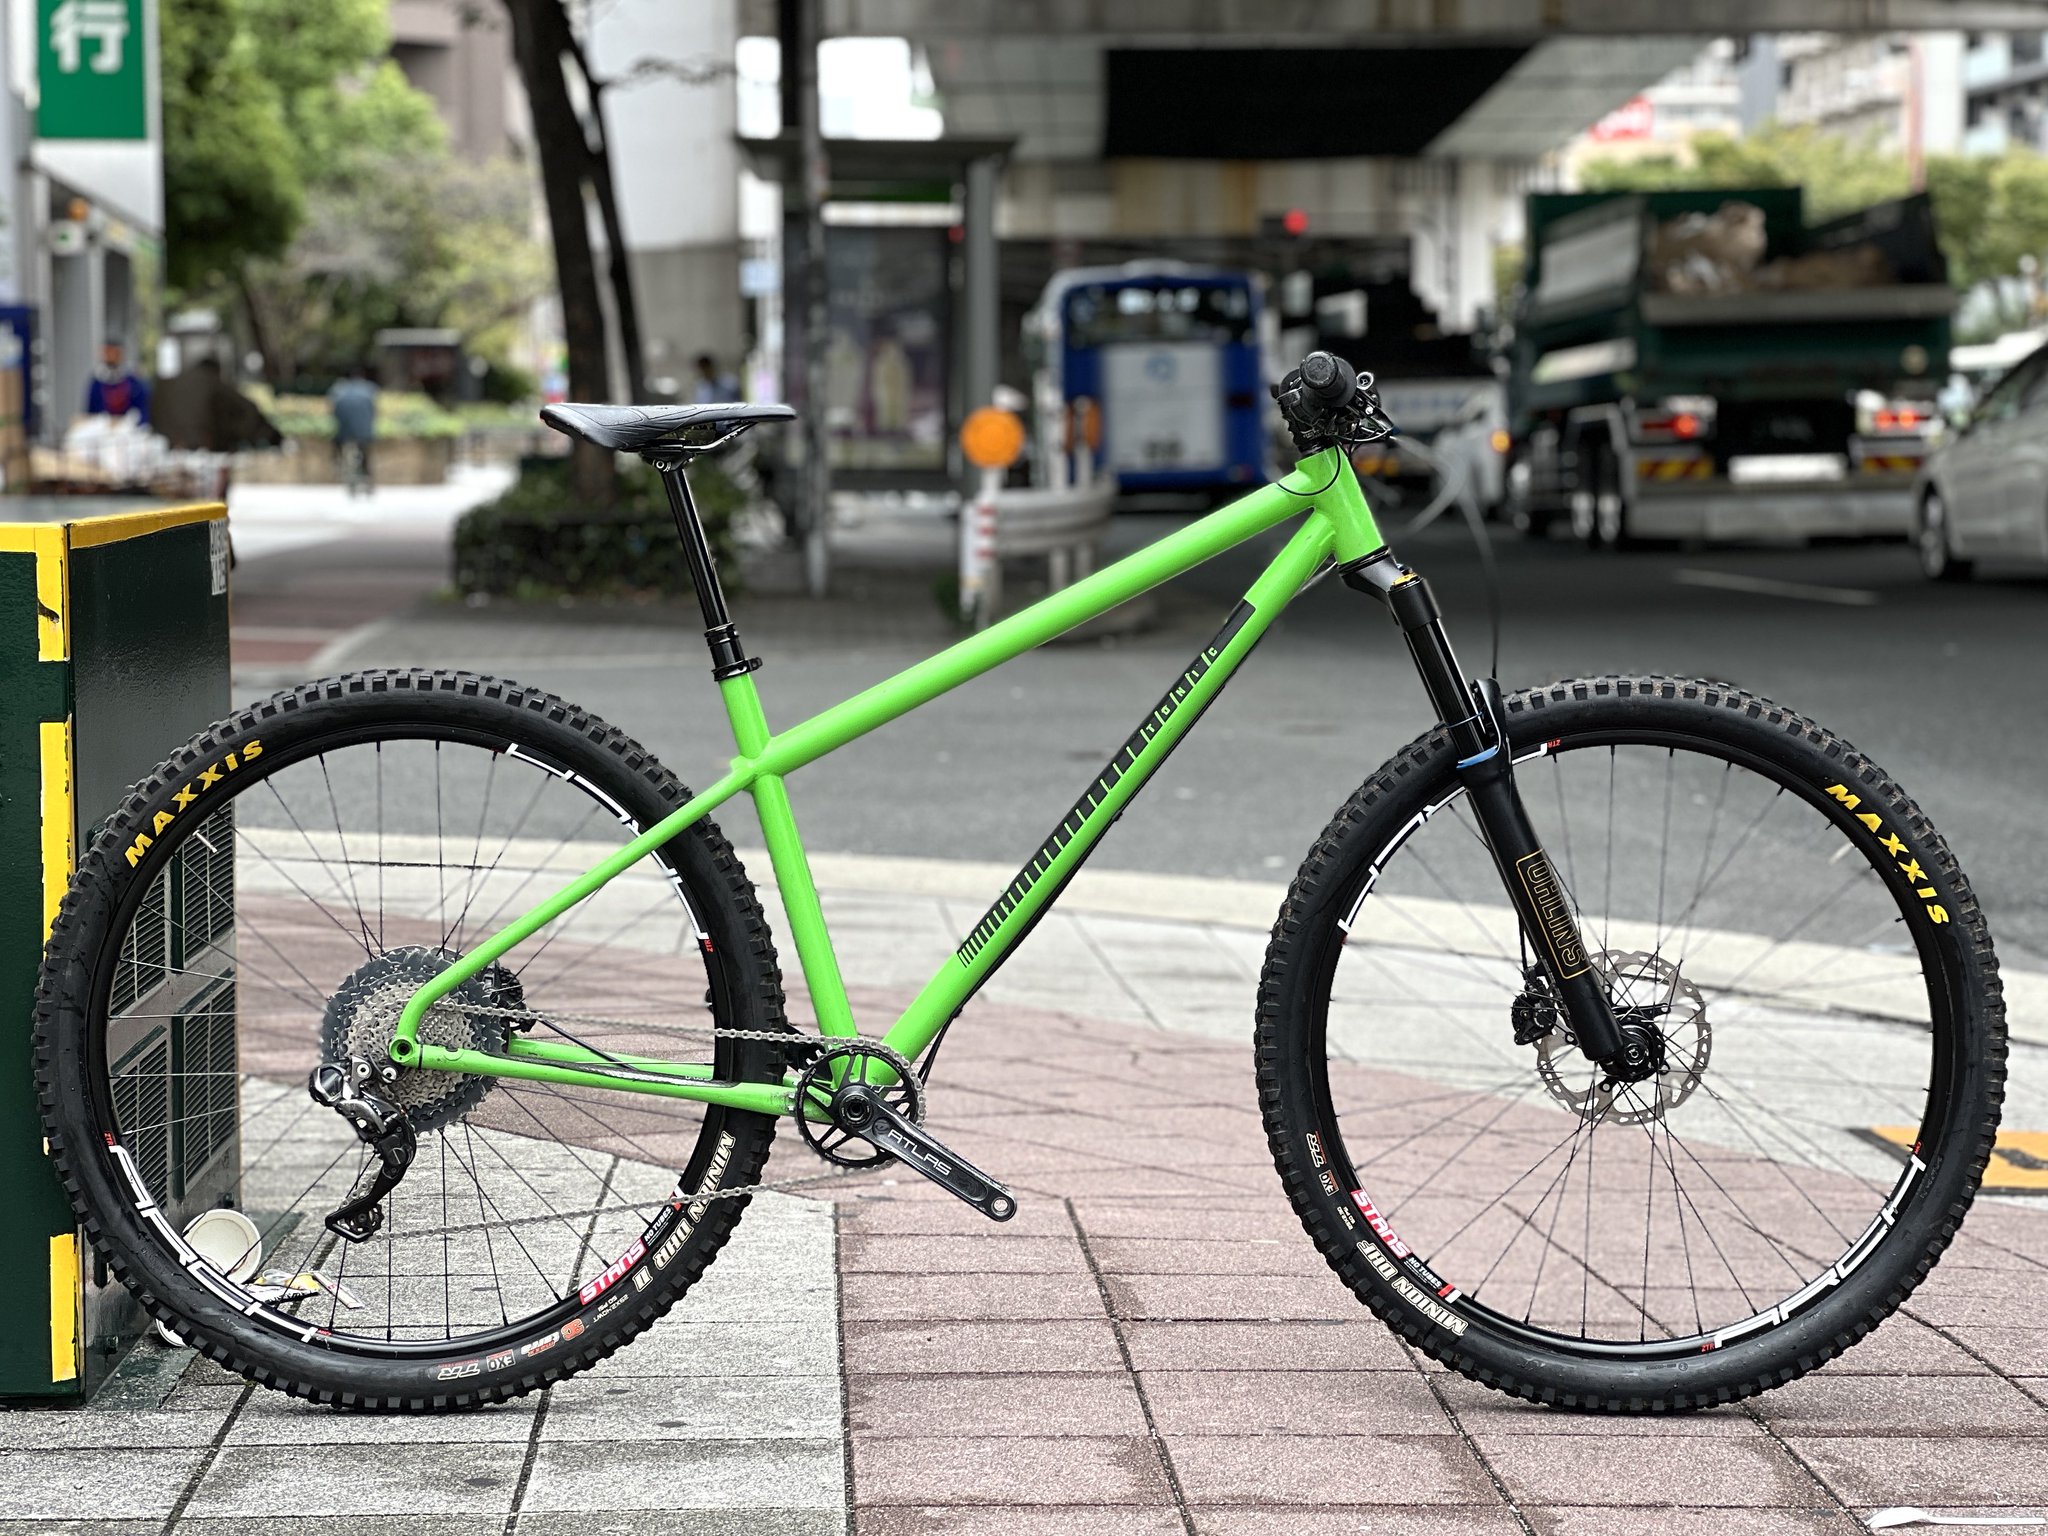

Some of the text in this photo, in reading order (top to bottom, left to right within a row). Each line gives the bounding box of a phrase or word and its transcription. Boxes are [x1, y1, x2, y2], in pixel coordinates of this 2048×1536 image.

[124, 739, 264, 868] MAXXIS
[1825, 783, 1949, 925] MAXXIS
[888, 1129, 952, 1176] ATLAS
[1320, 1173, 1334, 1195] EXO
[581, 1241, 646, 1302] STANS
[644, 1231, 655, 1242] NO
[654, 1207, 672, 1230] TUBES
[652, 1218, 694, 1270] DHR
[1354, 1190, 1409, 1257] STANS
[1409, 1257, 1420, 1269] NO
[1420, 1266, 1442, 1288] TUBES
[1356, 1240, 1398, 1281] DHF
[1391, 1277, 1468, 1336] MINION
[437, 1365, 480, 1380] TR
[488, 1354, 514, 1370] EXO
